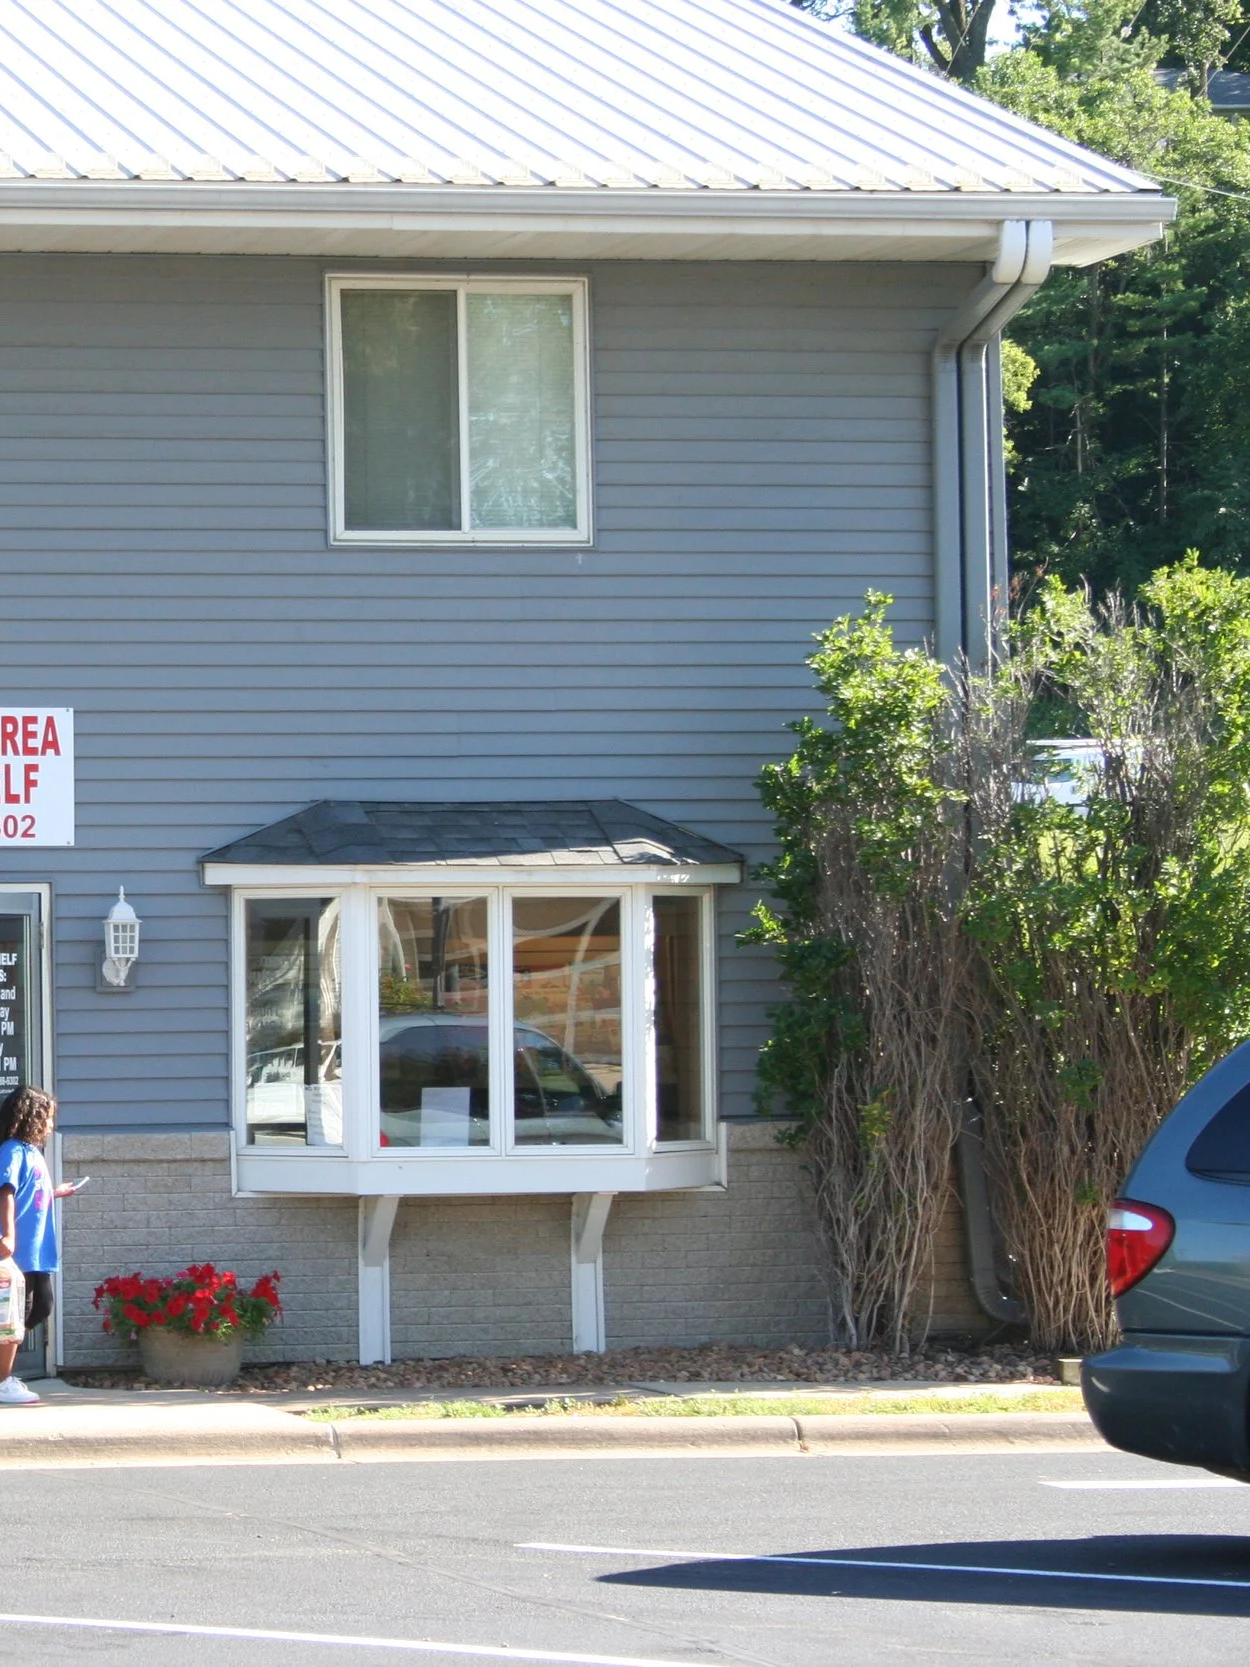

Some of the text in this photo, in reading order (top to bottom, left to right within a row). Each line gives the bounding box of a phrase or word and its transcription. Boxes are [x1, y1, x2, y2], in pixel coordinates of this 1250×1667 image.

[0, 986, 16, 1000] and
[1, 1021, 15, 1036] PM
[3, 1057, 16, 1071] PM
